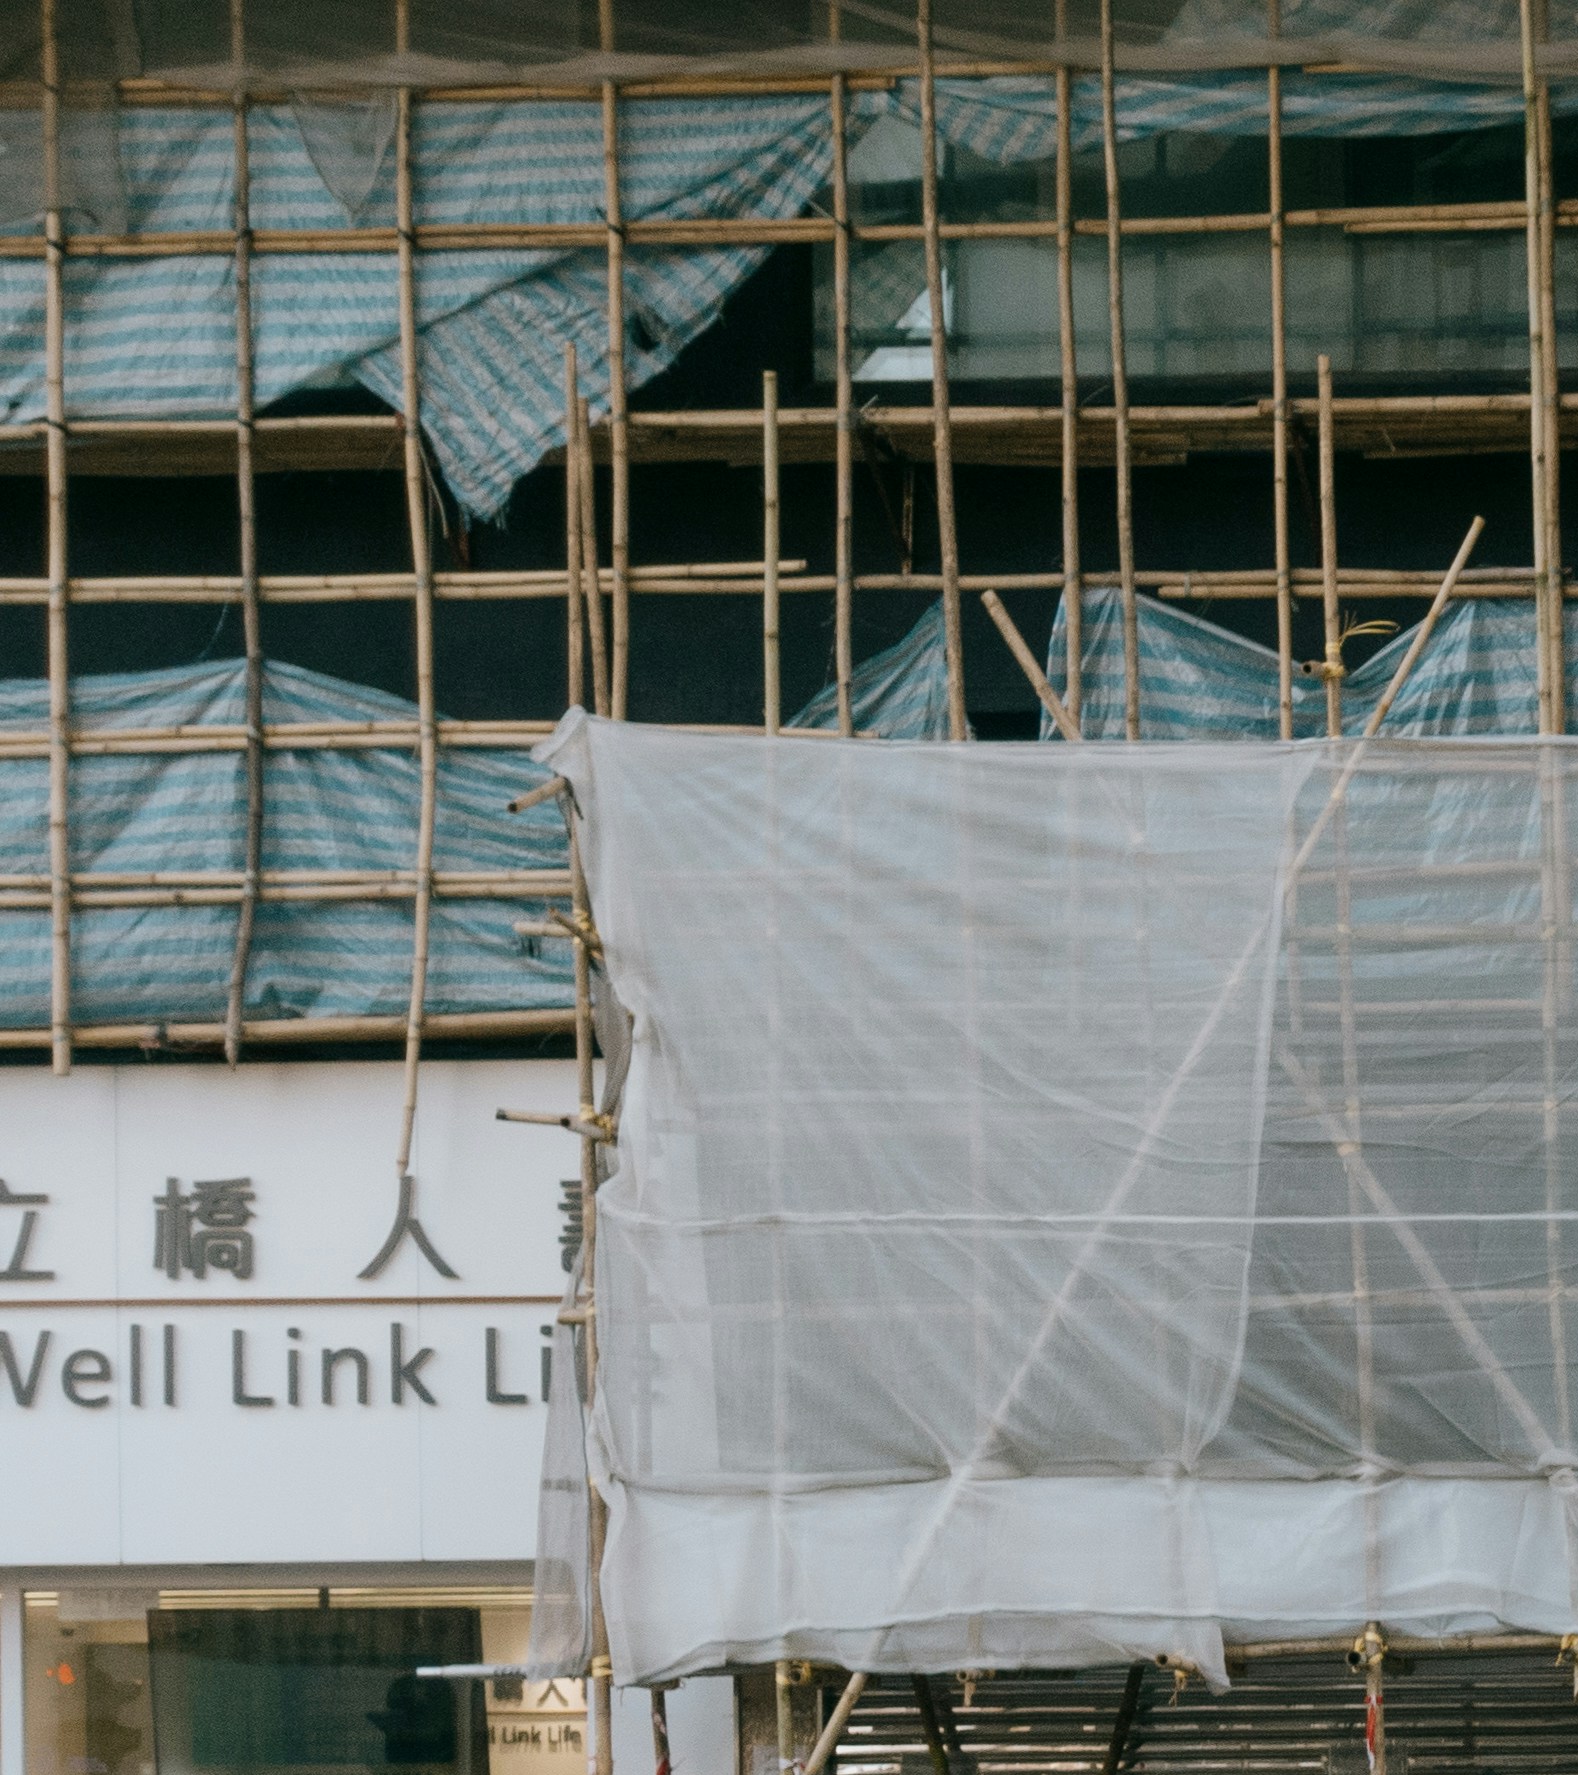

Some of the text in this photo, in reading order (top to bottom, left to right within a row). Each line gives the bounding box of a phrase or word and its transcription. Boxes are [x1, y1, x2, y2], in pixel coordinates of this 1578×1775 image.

[0, 1176, 583, 1280] 立橋人
[232, 1322, 438, 1407] Link
